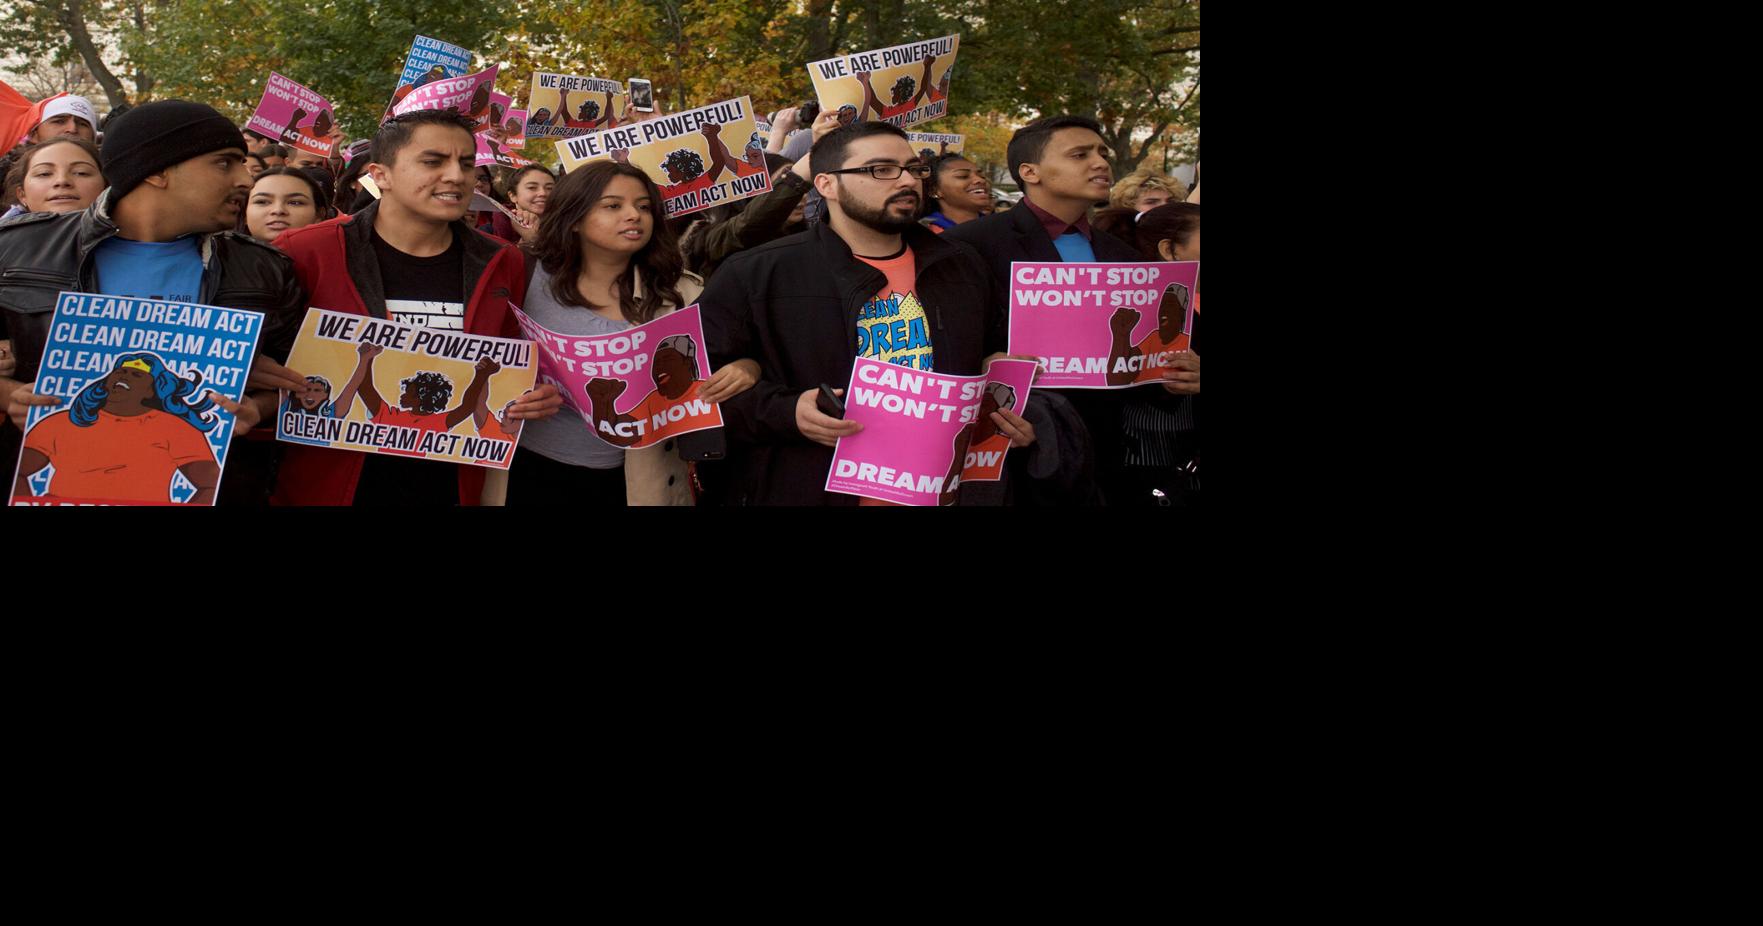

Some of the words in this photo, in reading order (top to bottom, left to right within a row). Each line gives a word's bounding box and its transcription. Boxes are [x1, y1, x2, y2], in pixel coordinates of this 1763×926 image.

[412, 48, 438, 62] CLEAN
[416, 37, 441, 51] CLEAN
[819, 59, 848, 80] WE
[850, 53, 881, 74] ARE
[882, 38, 954, 68] POWERFUL!
[271, 75, 300, 94] CAN'T
[300, 89, 321, 104] STOP
[436, 77, 476, 95] STOP
[540, 74, 559, 88] WE
[559, 77, 580, 90] ARE
[268, 85, 299, 104] WON'T
[297, 100, 320, 113] STOP
[442, 90, 473, 108] STOP
[906, 108, 923, 123] ACT
[924, 100, 945, 118] NOW
[251, 115, 286, 133] DREAM
[283, 129, 303, 142] ACT
[302, 136, 330, 151] NOW
[568, 139, 601, 160] WE
[603, 128, 642, 152] ARE
[642, 101, 744, 142] POWERFUL!
[917, 134, 961, 144] POWERFUL!
[664, 191, 698, 214] EAM
[700, 183, 729, 204] ACT
[731, 173, 766, 197] NOW
[1016, 267, 1102, 285] CAN'T
[1106, 267, 1160, 285] STOP
[1015, 290, 1105, 307] WON'T
[1109, 290, 1158, 306] STOP
[62, 295, 130, 321] CLEAN
[136, 302, 211, 329] DREAM
[214, 312, 258, 335] ACT
[54, 322, 126, 348] CLEAN
[128, 329, 204, 356] DREAM
[207, 338, 250, 361] ACT
[317, 314, 359, 341] WE
[359, 321, 411, 349] ARE
[411, 330, 531, 368] POWERFUL!
[574, 331, 647, 357] STOP
[857, 317, 933, 355] DREA
[47, 349, 117, 374] CLEAN
[204, 364, 243, 387] ACT
[582, 353, 649, 377] STOP
[1038, 357, 1108, 374] REAM
[1113, 355, 1146, 374] ACT
[40, 375, 92, 398] CLE
[858, 364, 957, 401] CAN'T
[599, 419, 648, 438] ACT
[652, 400, 712, 431] NOW
[853, 387, 957, 423] WON'T
[283, 412, 342, 438] CLEAN
[344, 422, 418, 450] DREAM
[419, 432, 466, 455] ACT
[461, 438, 510, 462] NOW
[835, 459, 945, 495] DREAM
[964, 450, 1002, 469] OW
